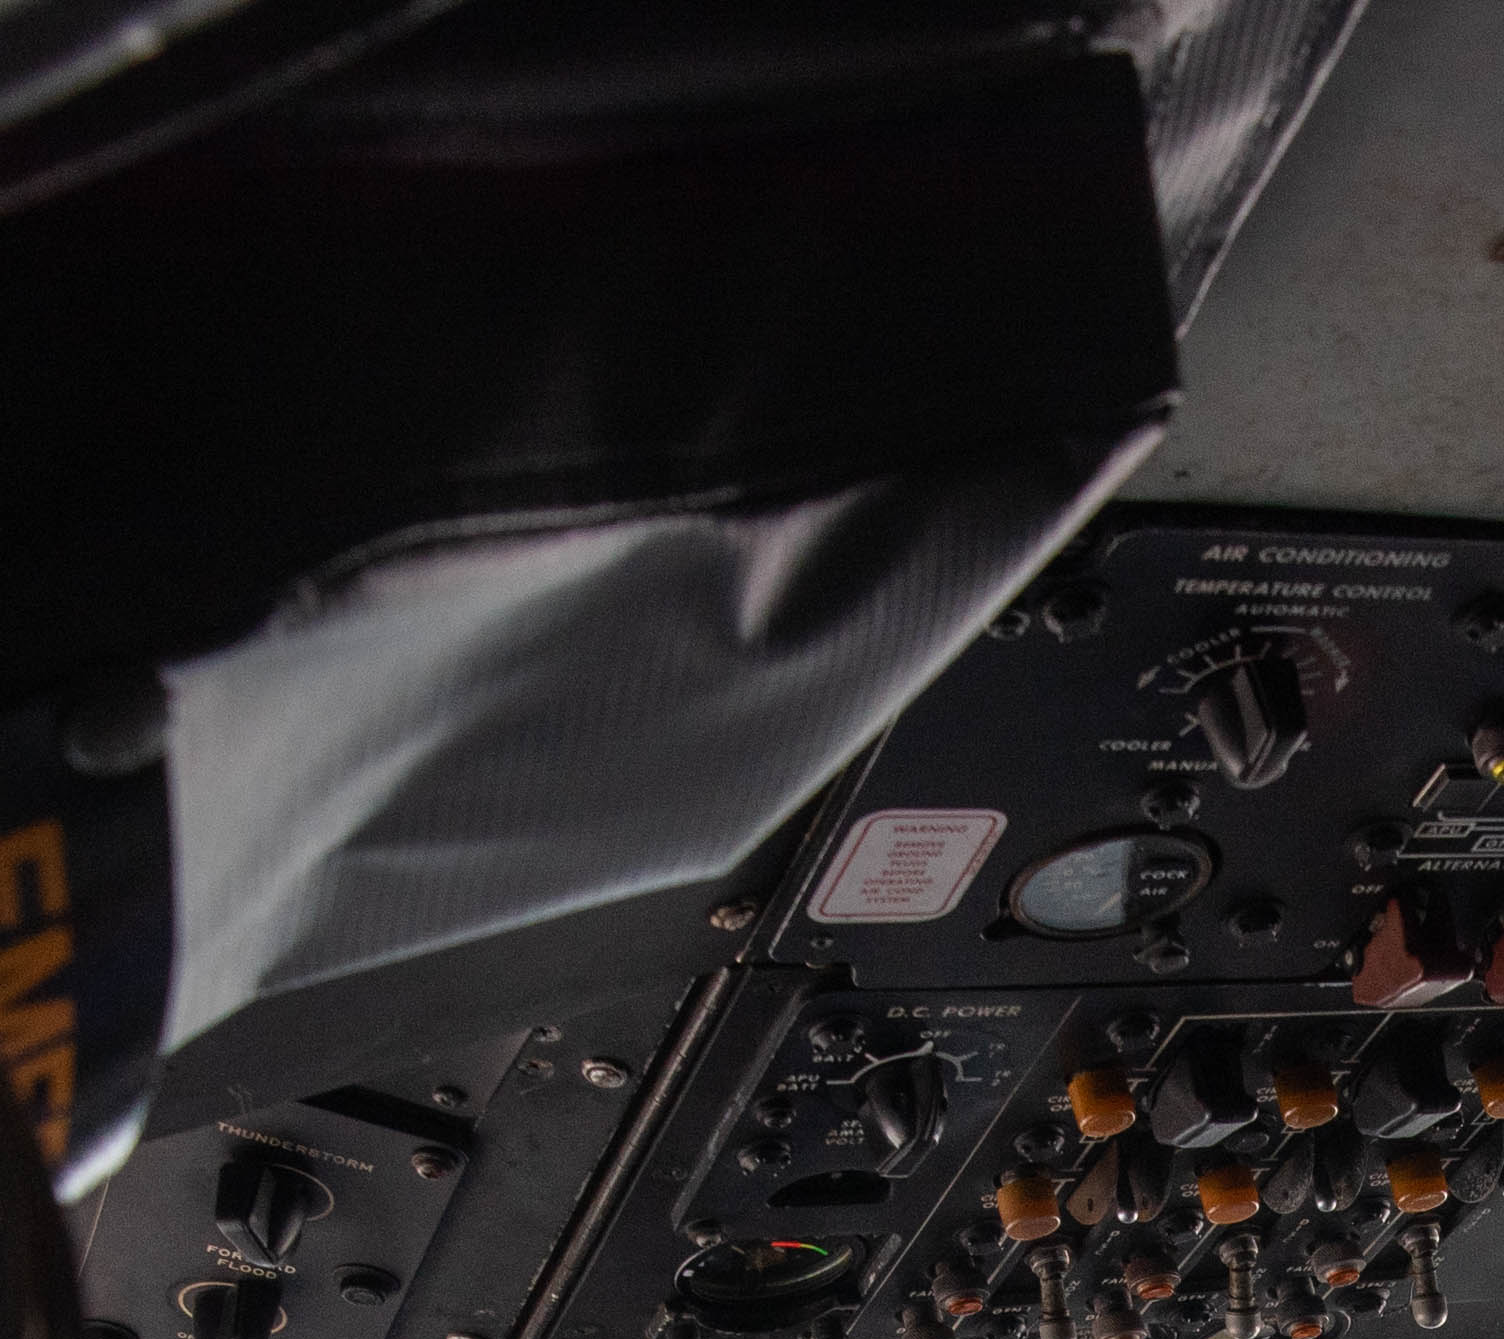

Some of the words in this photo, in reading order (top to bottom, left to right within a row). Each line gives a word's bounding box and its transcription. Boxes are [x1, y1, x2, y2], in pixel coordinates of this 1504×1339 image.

[1200, 545, 1250, 562] AIR
[1258, 547, 1451, 568] CONDITIONING
[1174, 579, 1326, 598] TEMPERATURE
[1332, 584, 1434, 601] CONTROL
[1147, 760, 1220, 772] MANUA
[1351, 884, 1384, 895] OFF
[942, 1005, 1023, 1018] POWER
[216, 1121, 375, 1173] THUNDERSTORM
[216, 1258, 277, 1280] FLOOD
